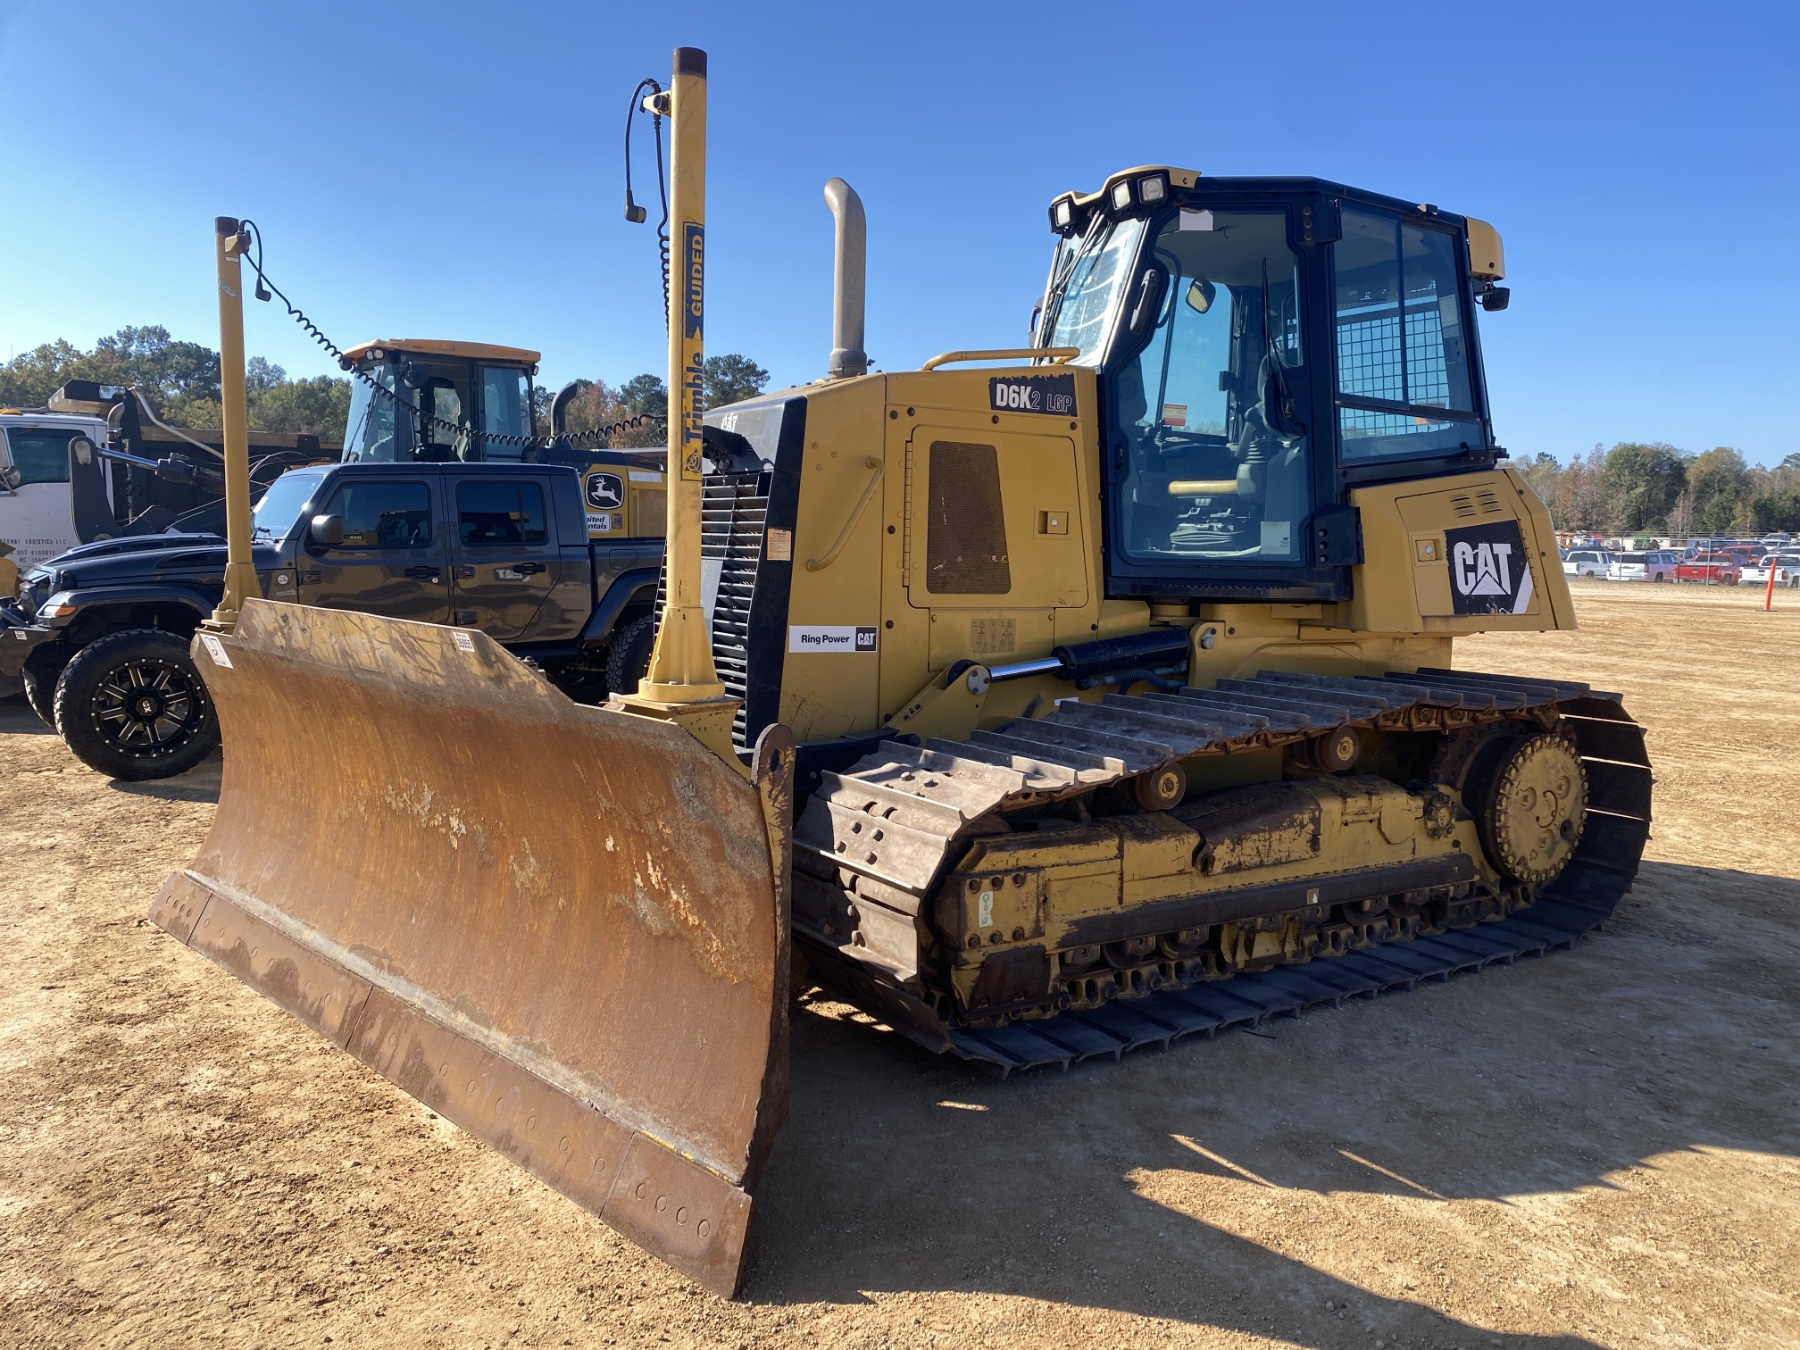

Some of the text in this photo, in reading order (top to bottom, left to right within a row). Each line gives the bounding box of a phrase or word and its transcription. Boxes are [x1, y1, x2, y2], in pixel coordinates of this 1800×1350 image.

[685, 235, 704, 443] Trimble GUIDED
[996, 383, 1073, 413] D6K2 LGP
[1453, 541, 1512, 596] CAT
[801, 634, 850, 645] Ring Power
[857, 632, 876, 646] CAT
